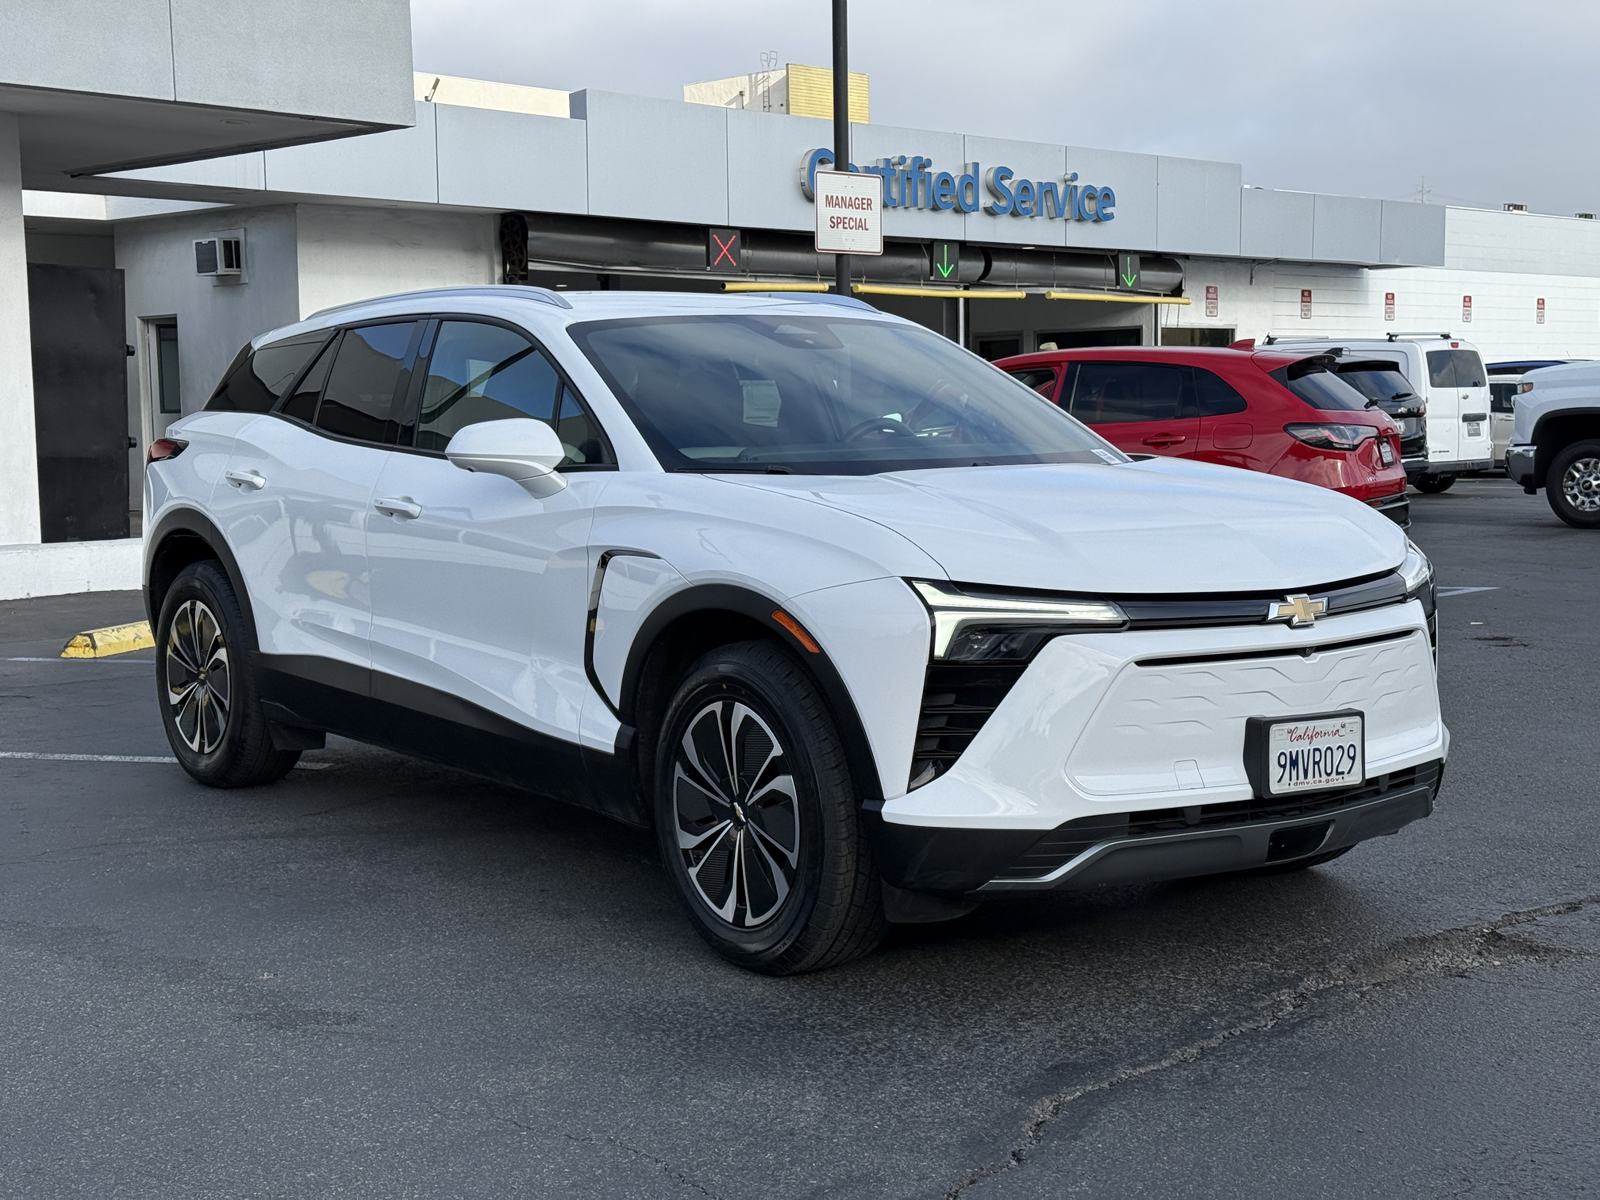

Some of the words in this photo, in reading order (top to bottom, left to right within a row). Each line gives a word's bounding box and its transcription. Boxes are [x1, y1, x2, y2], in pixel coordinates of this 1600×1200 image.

[807, 148, 980, 213] Ctified
[990, 166, 1116, 222] Service
[825, 194, 873, 211] MANAGER
[829, 215, 869, 231] SPECIAL
[1289, 725, 1346, 745] California
[1276, 743, 1357, 784] 9MVR029
[1293, 777, 1340, 787] dmv.ca.gov
